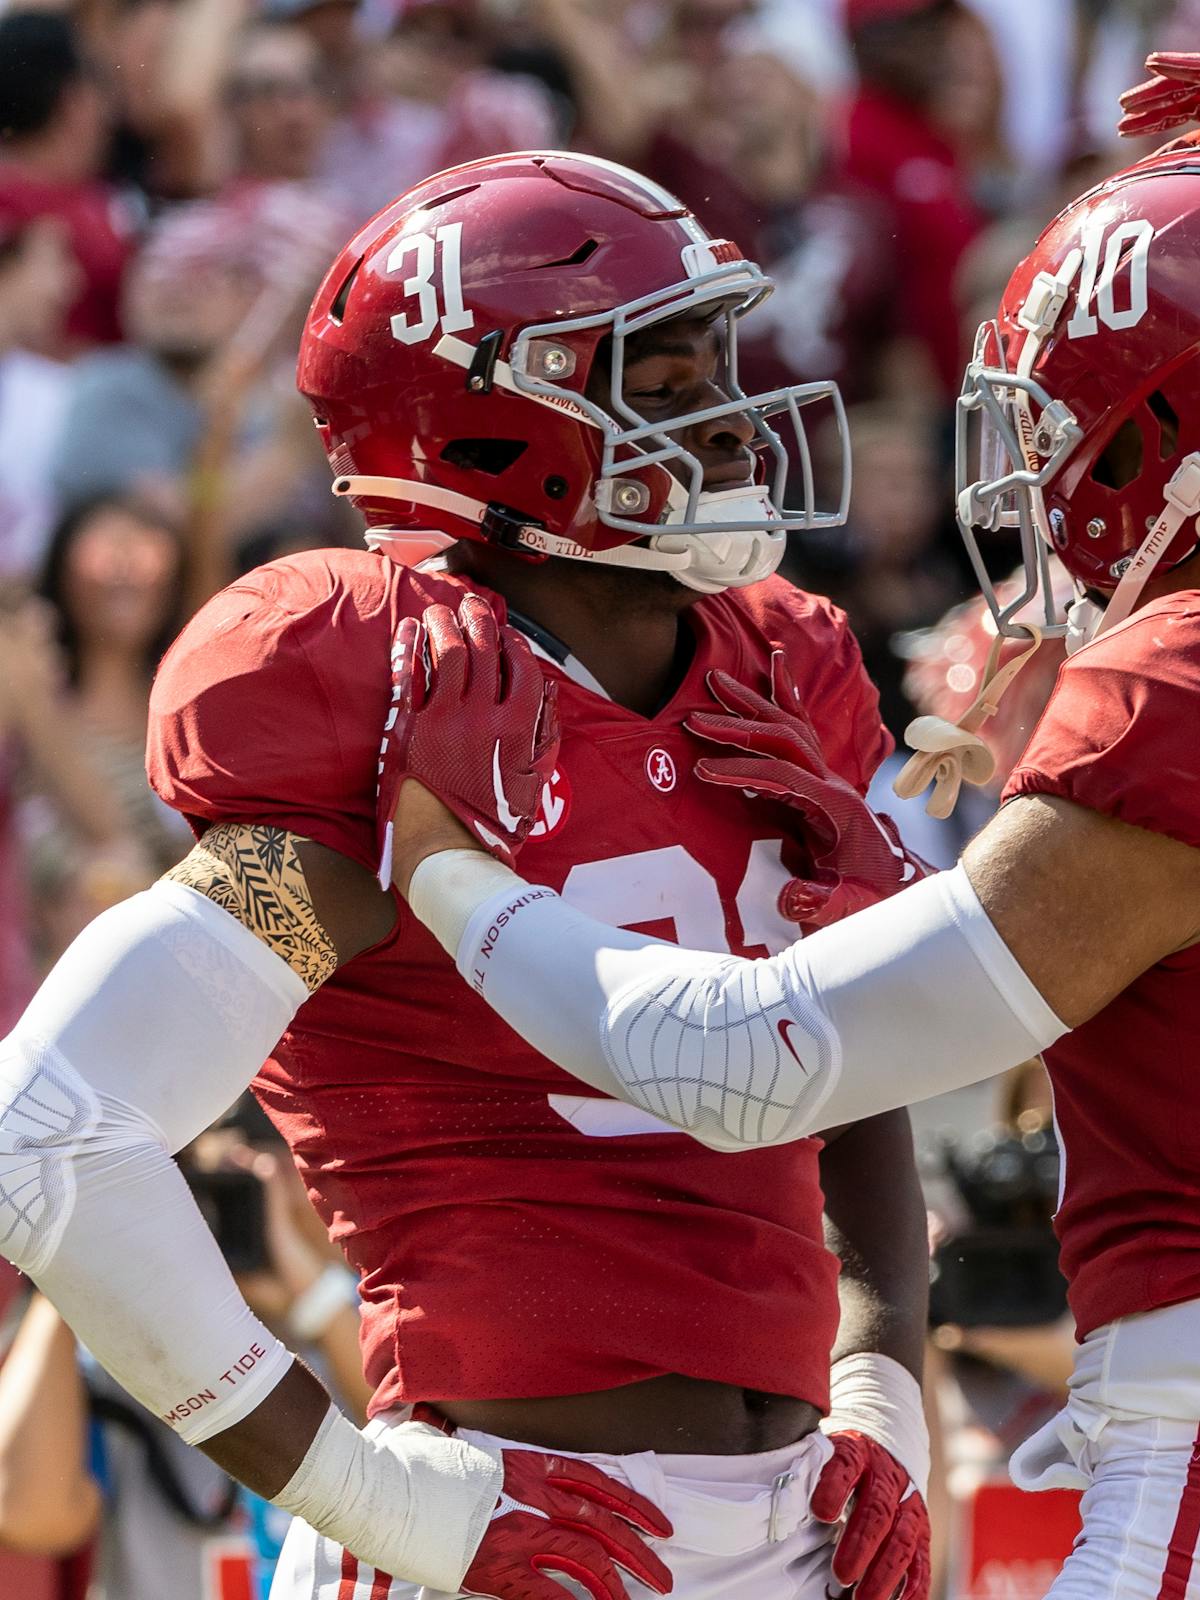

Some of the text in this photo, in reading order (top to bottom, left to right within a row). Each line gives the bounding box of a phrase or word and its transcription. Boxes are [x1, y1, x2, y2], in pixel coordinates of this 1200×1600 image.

[386, 222, 475, 345] 31
[1067, 219, 1155, 339] 10
[473, 890, 557, 995] CRIMSON TI
[219, 1343, 266, 1385] TIDE
